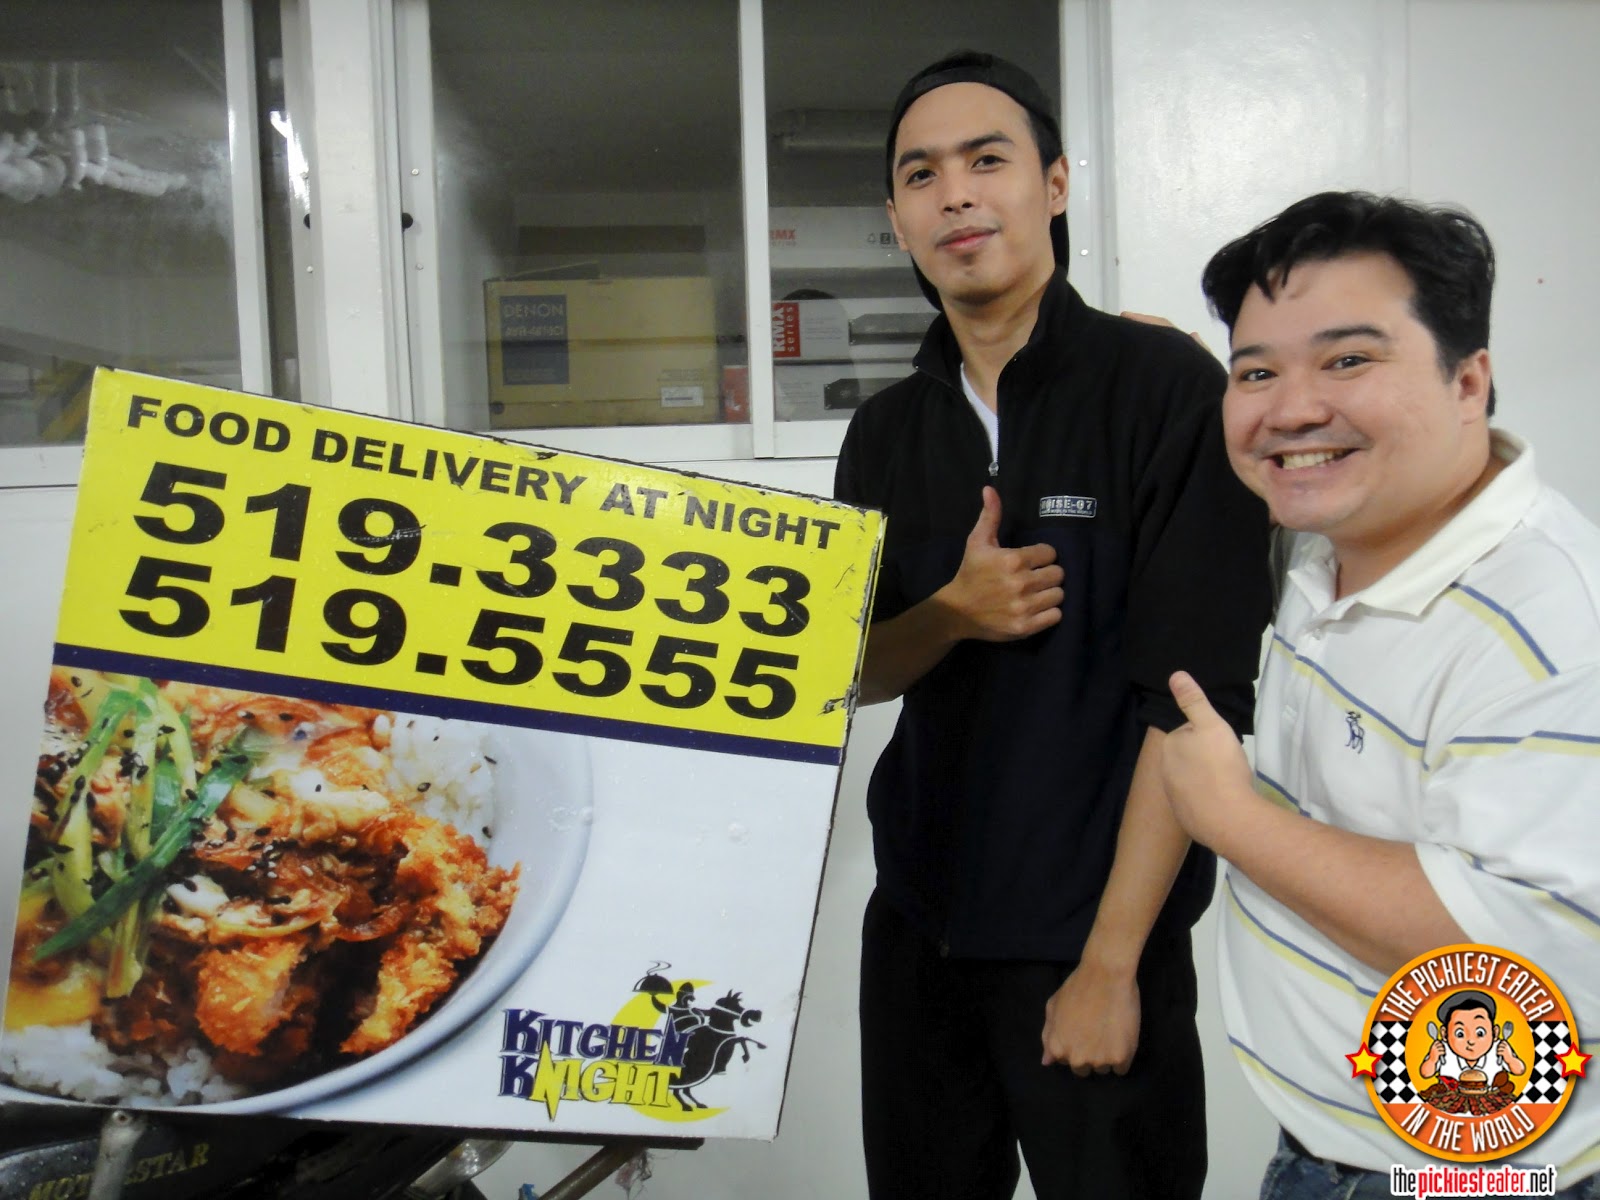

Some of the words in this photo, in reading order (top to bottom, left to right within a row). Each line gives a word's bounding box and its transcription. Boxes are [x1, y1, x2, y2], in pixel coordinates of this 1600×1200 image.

[503, 303, 564, 318] DENON
[786, 306, 795, 352] series
[127, 395, 291, 454] FOOD
[310, 428, 588, 506] DELIVERY
[600, 484, 667, 521] AT
[684, 496, 841, 551] NIGHT
[132, 461, 812, 639] 519.3333
[118, 555, 799, 721] 519.5555
[500, 1008, 696, 1068] KITCHEN
[497, 1054, 682, 1122] KNIGHT
